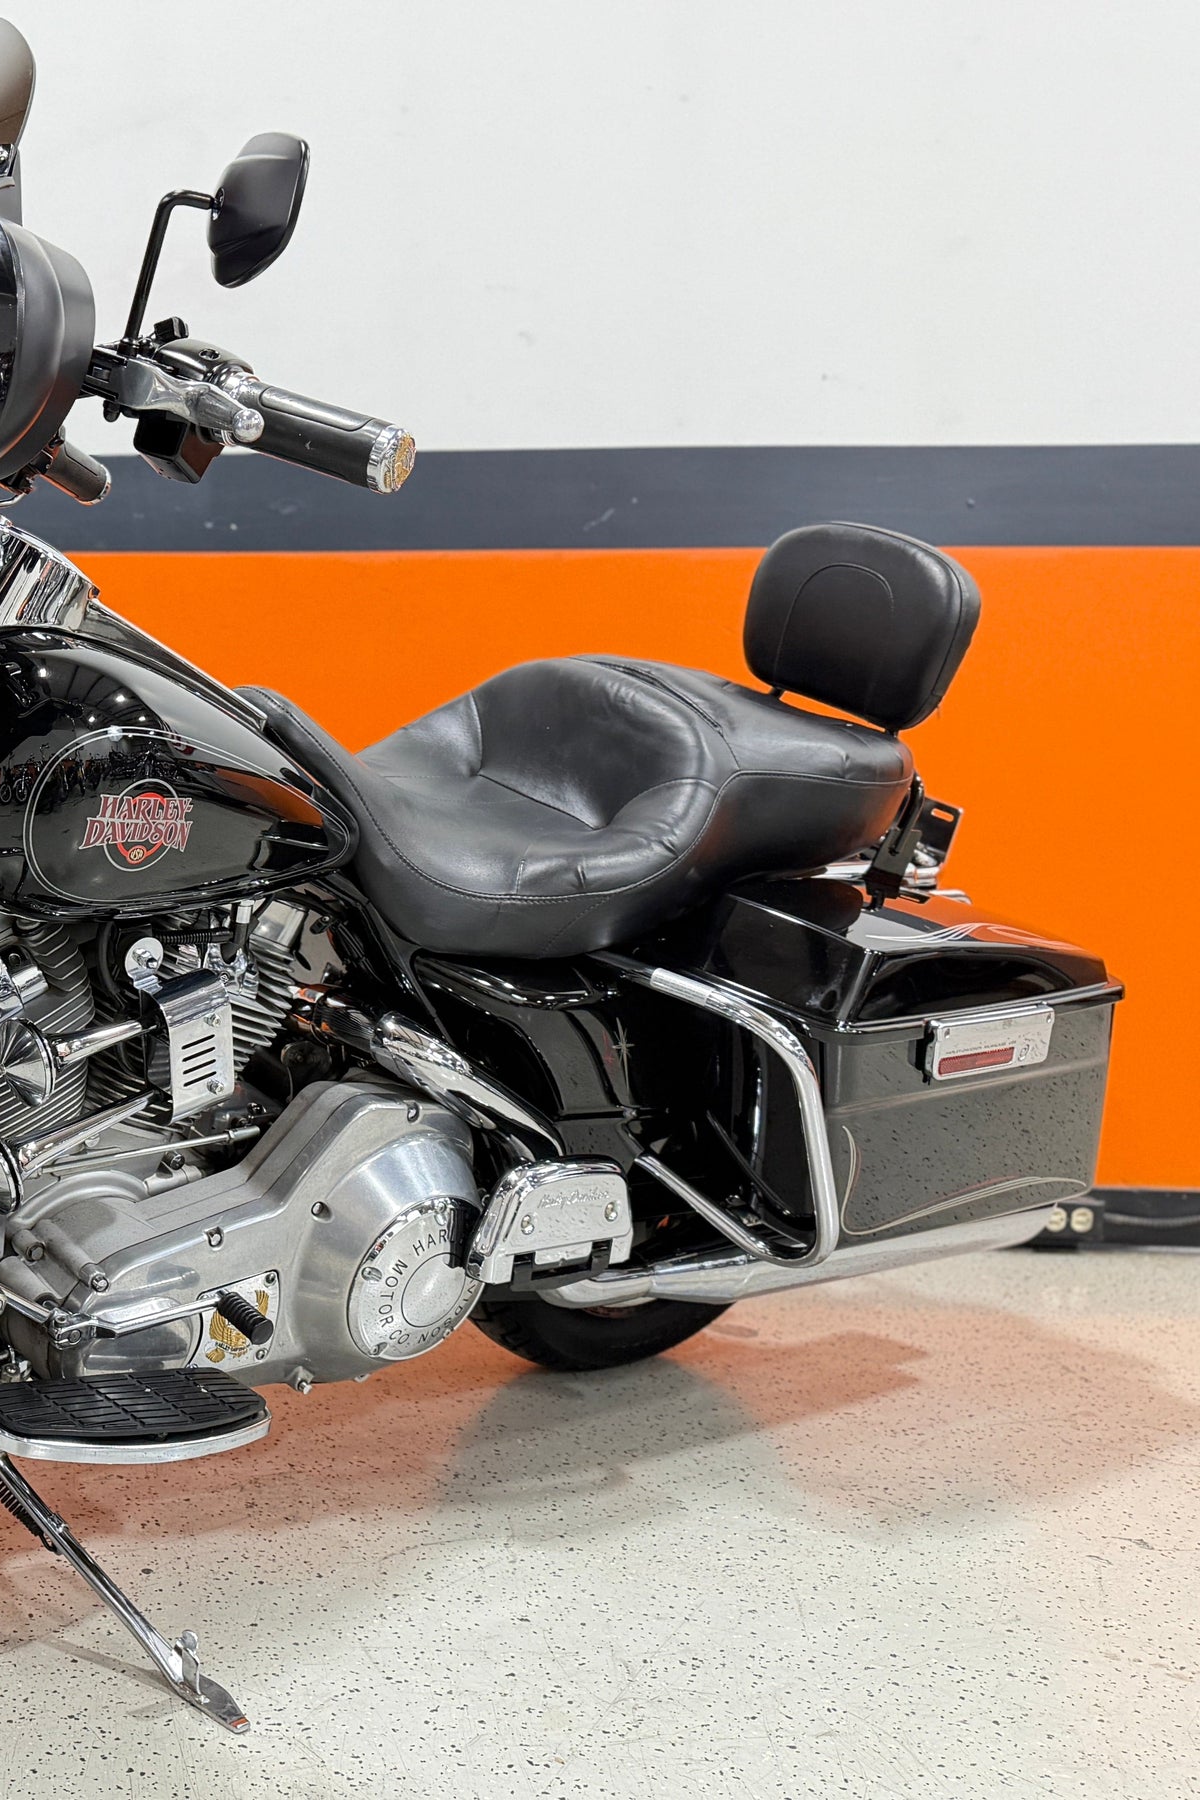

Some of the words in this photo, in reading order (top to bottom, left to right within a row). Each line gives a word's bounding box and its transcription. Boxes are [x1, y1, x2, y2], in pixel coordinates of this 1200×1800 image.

[97, 794, 193, 823] HARLEY-
[79, 817, 194, 852] DAVIDSON
[130, 848, 144, 861] USA
[379, 1259, 409, 1328] MOTOR
